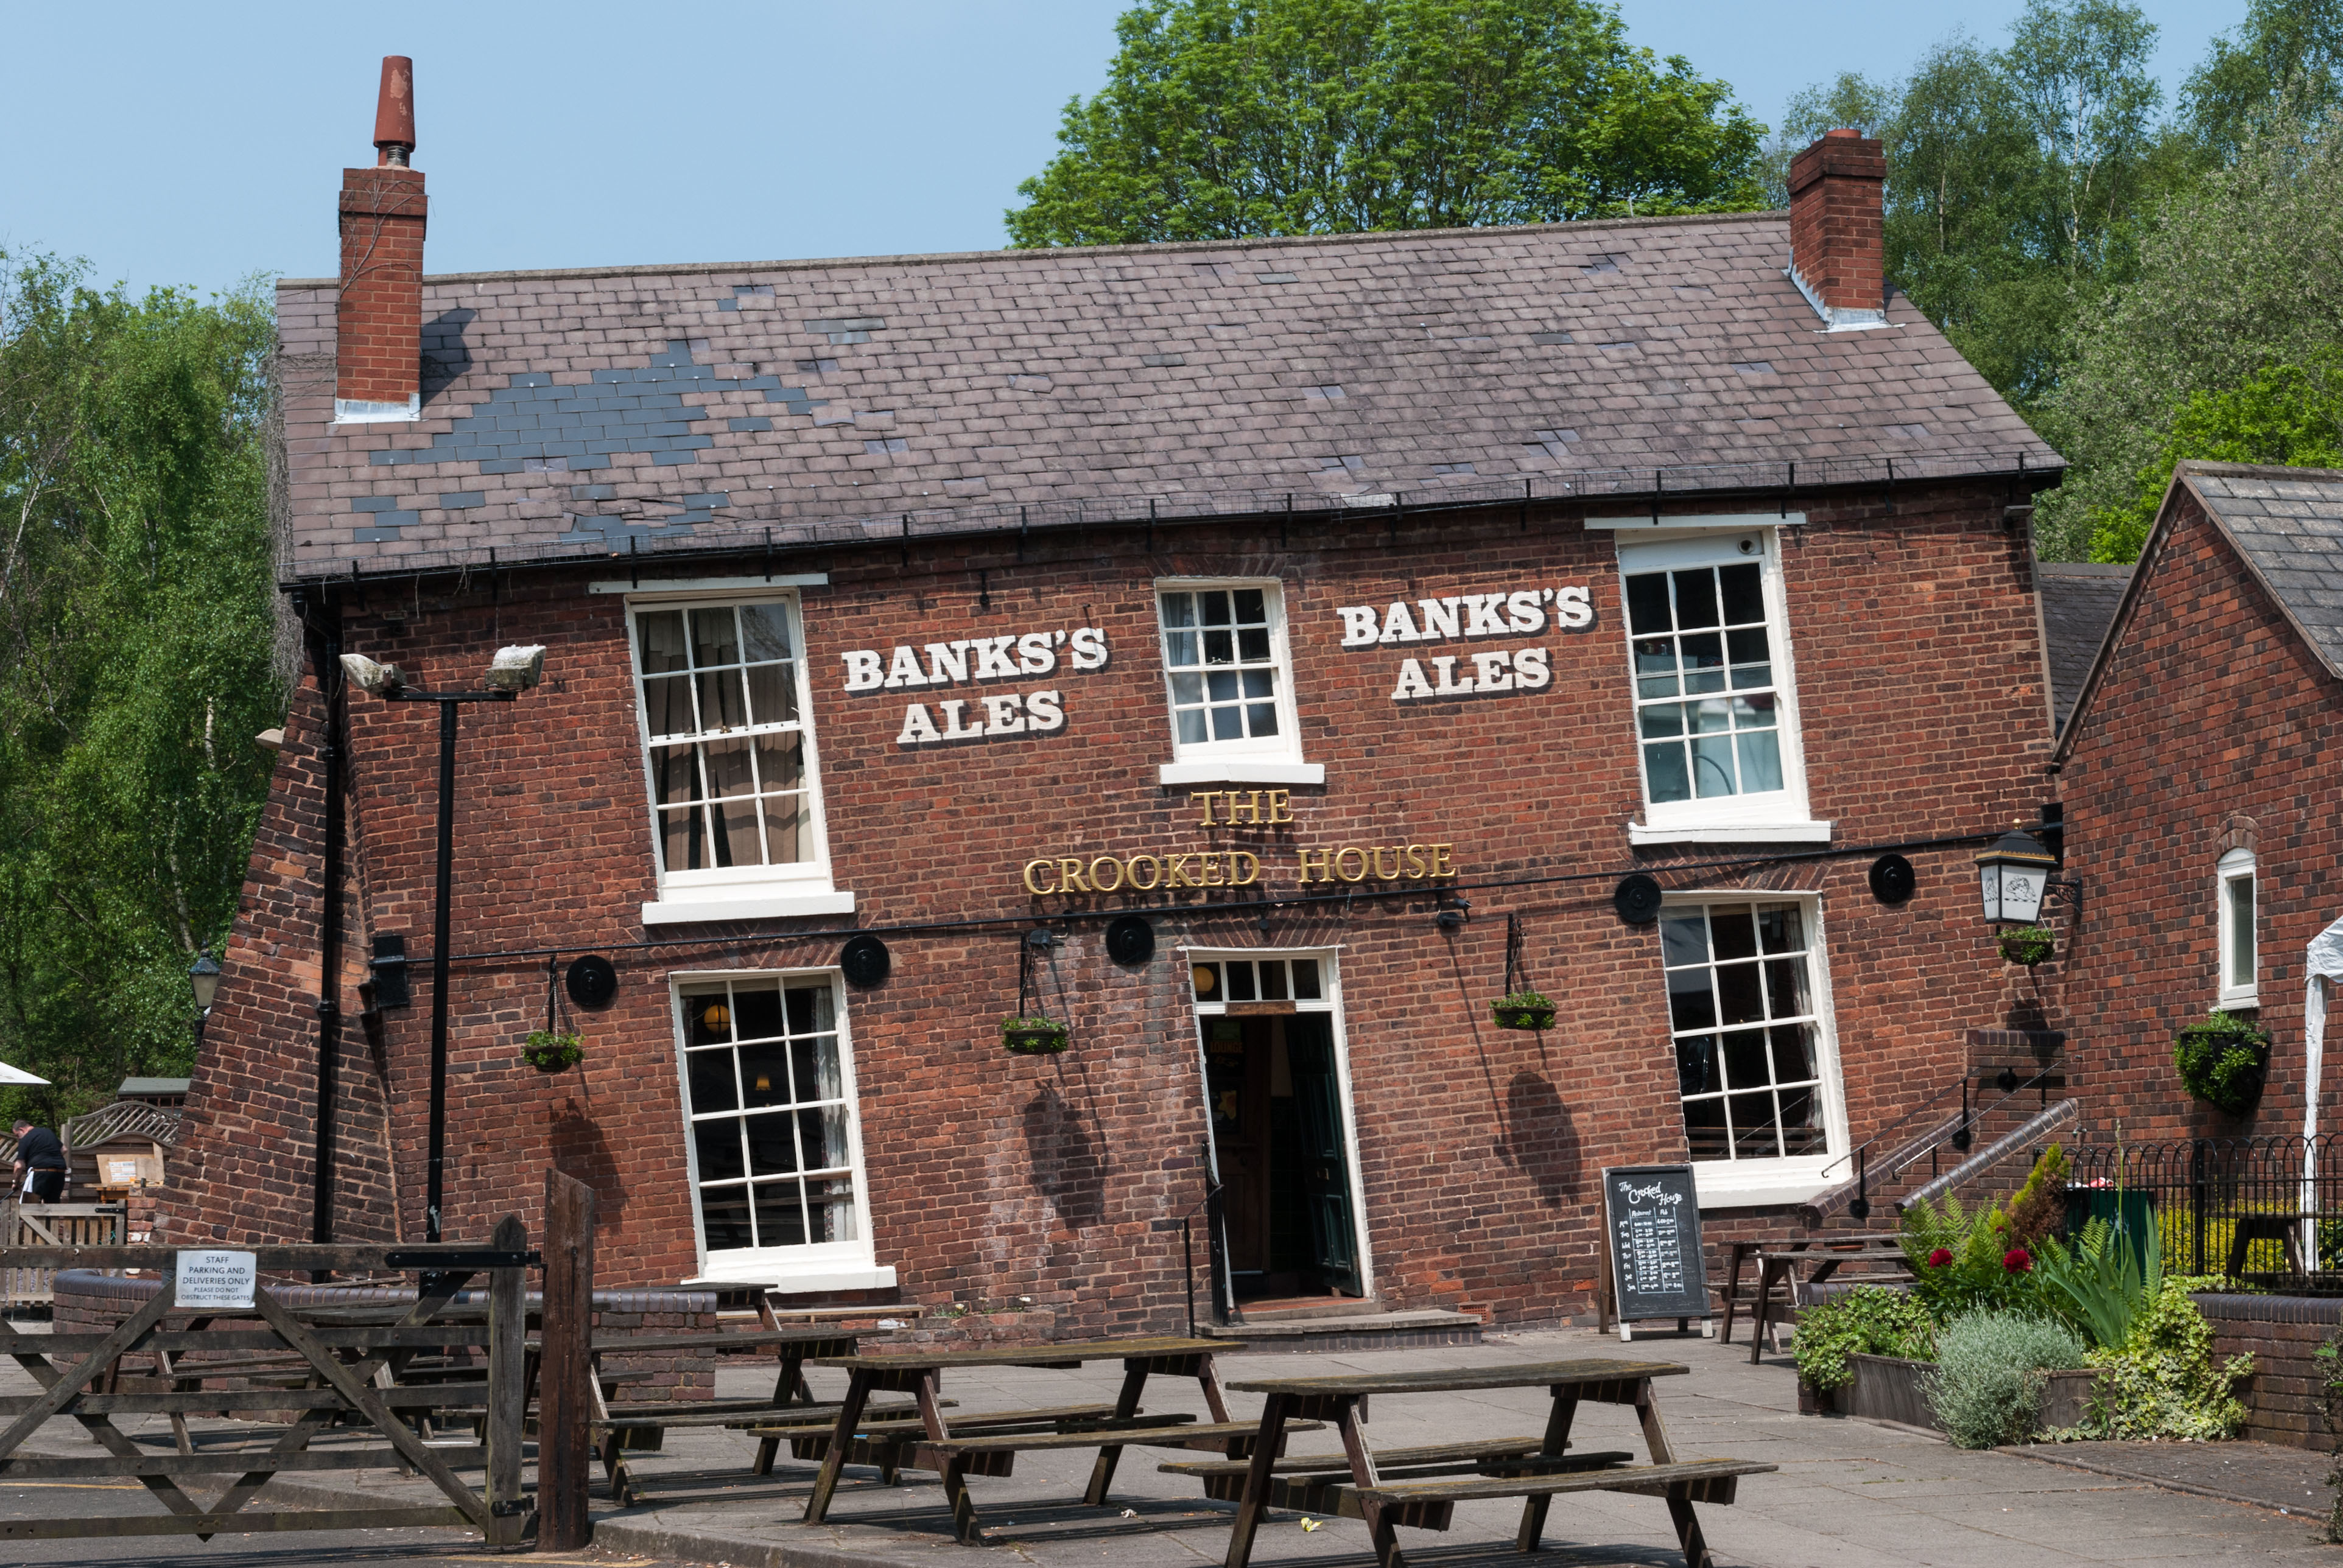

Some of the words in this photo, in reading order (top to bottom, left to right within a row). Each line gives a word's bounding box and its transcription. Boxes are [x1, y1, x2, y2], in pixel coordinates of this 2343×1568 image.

[1337, 586, 1593, 646] BANKS'S
[841, 628, 1108, 691] BANKS'S
[1391, 648, 1550, 700] ALES
[896, 690, 1064, 744] ALES
[1190, 789, 1294, 827] THE
[1024, 851, 1261, 895] CROOKED
[1296, 844, 1456, 884] HOUSE
[1210, 1041, 1244, 1053] LOUNGE
[1618, 1181, 1632, 1192] The
[1628, 1181, 1661, 1204] Crooked
[1656, 1193, 1682, 1206] House
